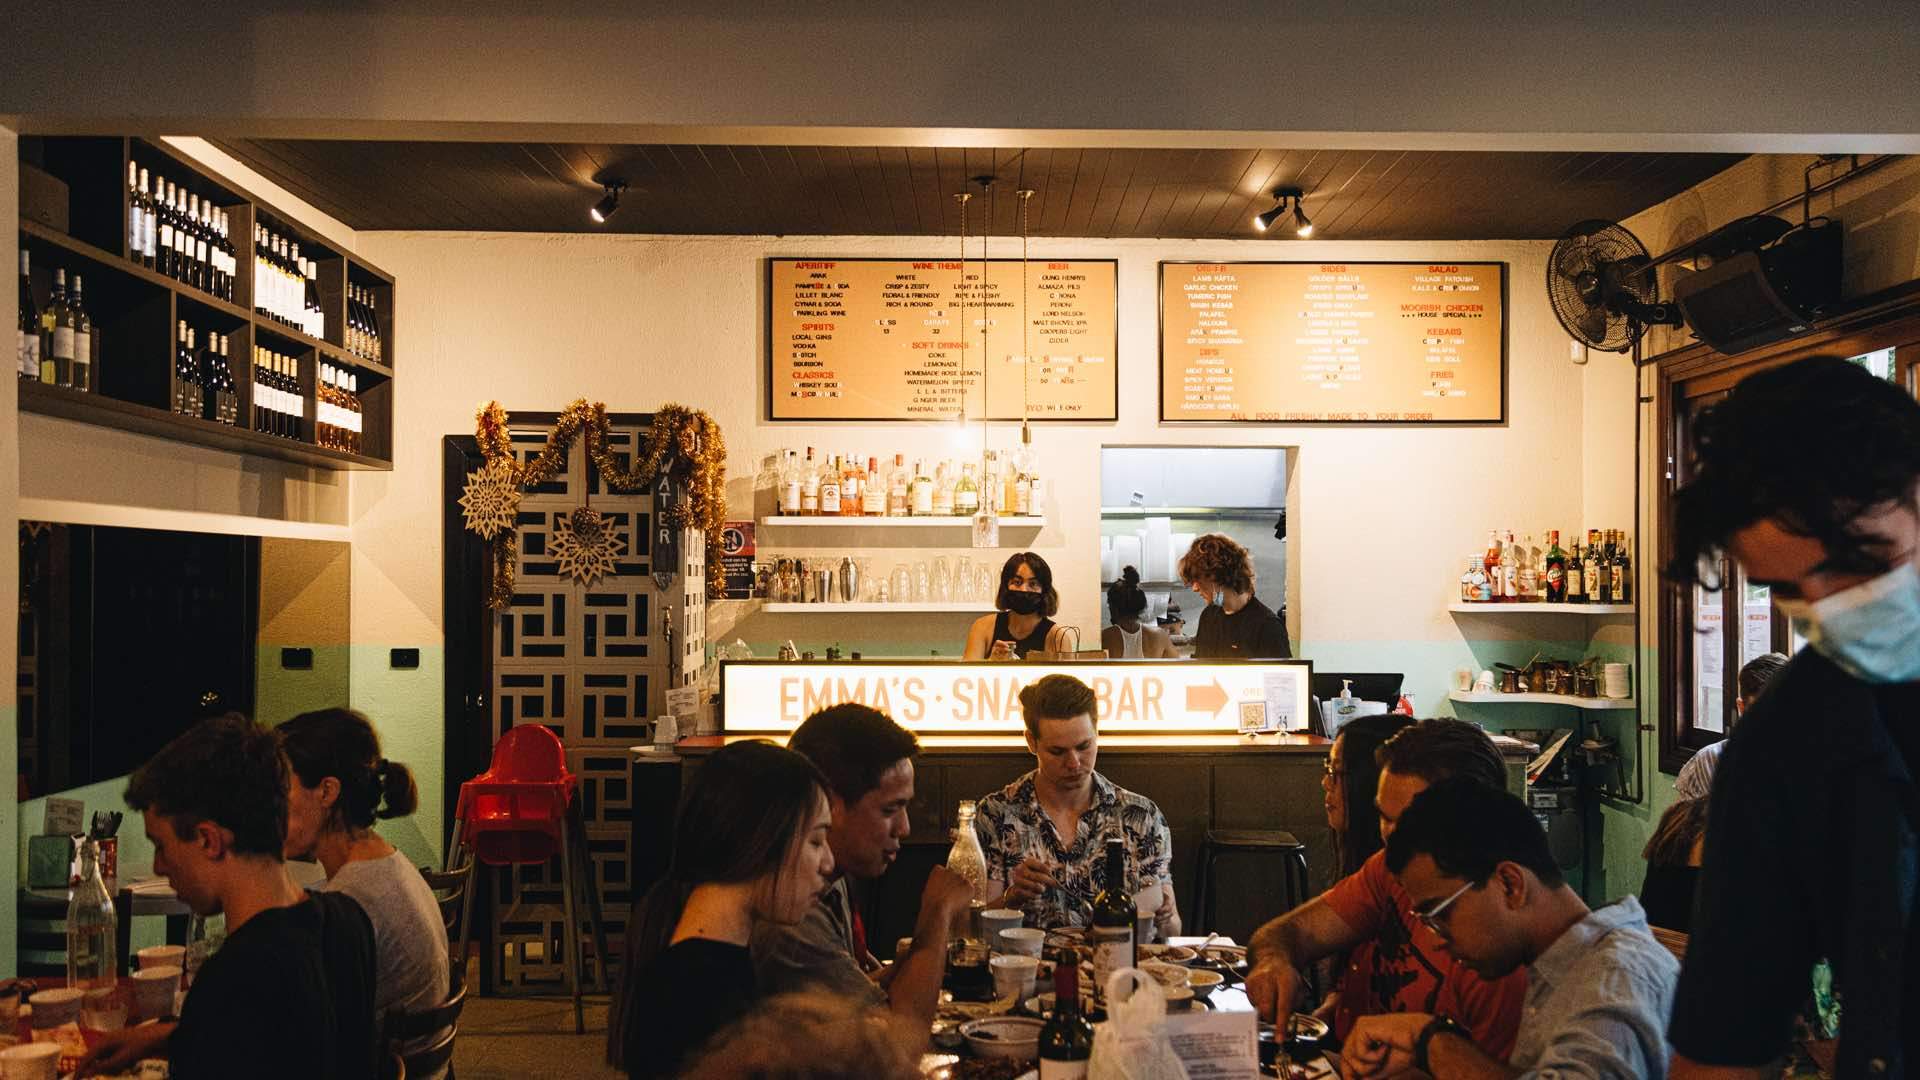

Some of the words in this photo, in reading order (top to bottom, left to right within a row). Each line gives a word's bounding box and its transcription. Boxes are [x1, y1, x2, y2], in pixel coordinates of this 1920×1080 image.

[1401, 304, 1441, 312] MOORISH
[1445, 304, 1483, 312] CHICKEN
[802, 323, 834, 331] SPIRITS
[659, 458, 674, 544] WATER
[780, 677, 926, 721] EMMA'S
[952, 677, 1030, 721] SNA
[1091, 677, 1164, 720] BAR
